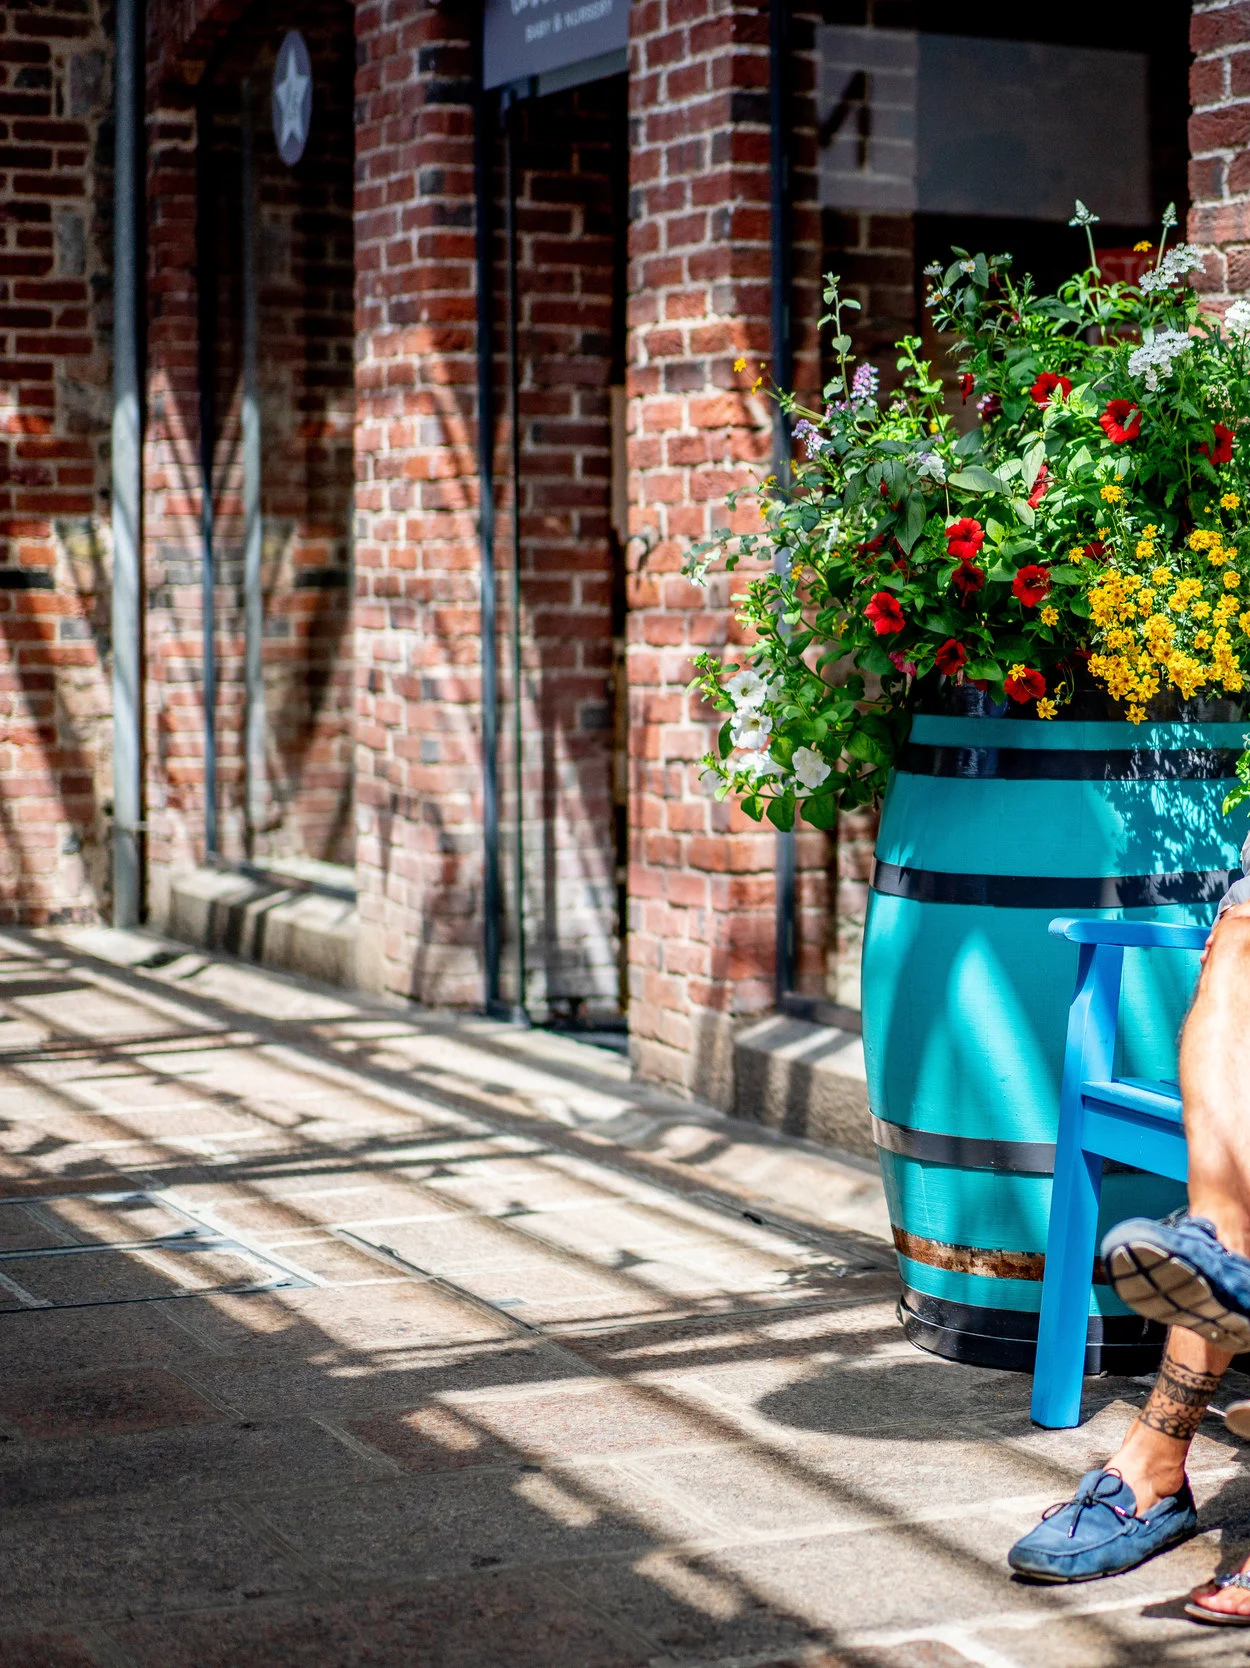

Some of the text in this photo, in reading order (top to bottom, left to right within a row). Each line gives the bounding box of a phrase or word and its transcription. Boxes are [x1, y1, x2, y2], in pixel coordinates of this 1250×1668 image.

[525, 19, 551, 43] BABY
[553, 12, 563, 33] &
[564, 0, 613, 28] NURSERY
